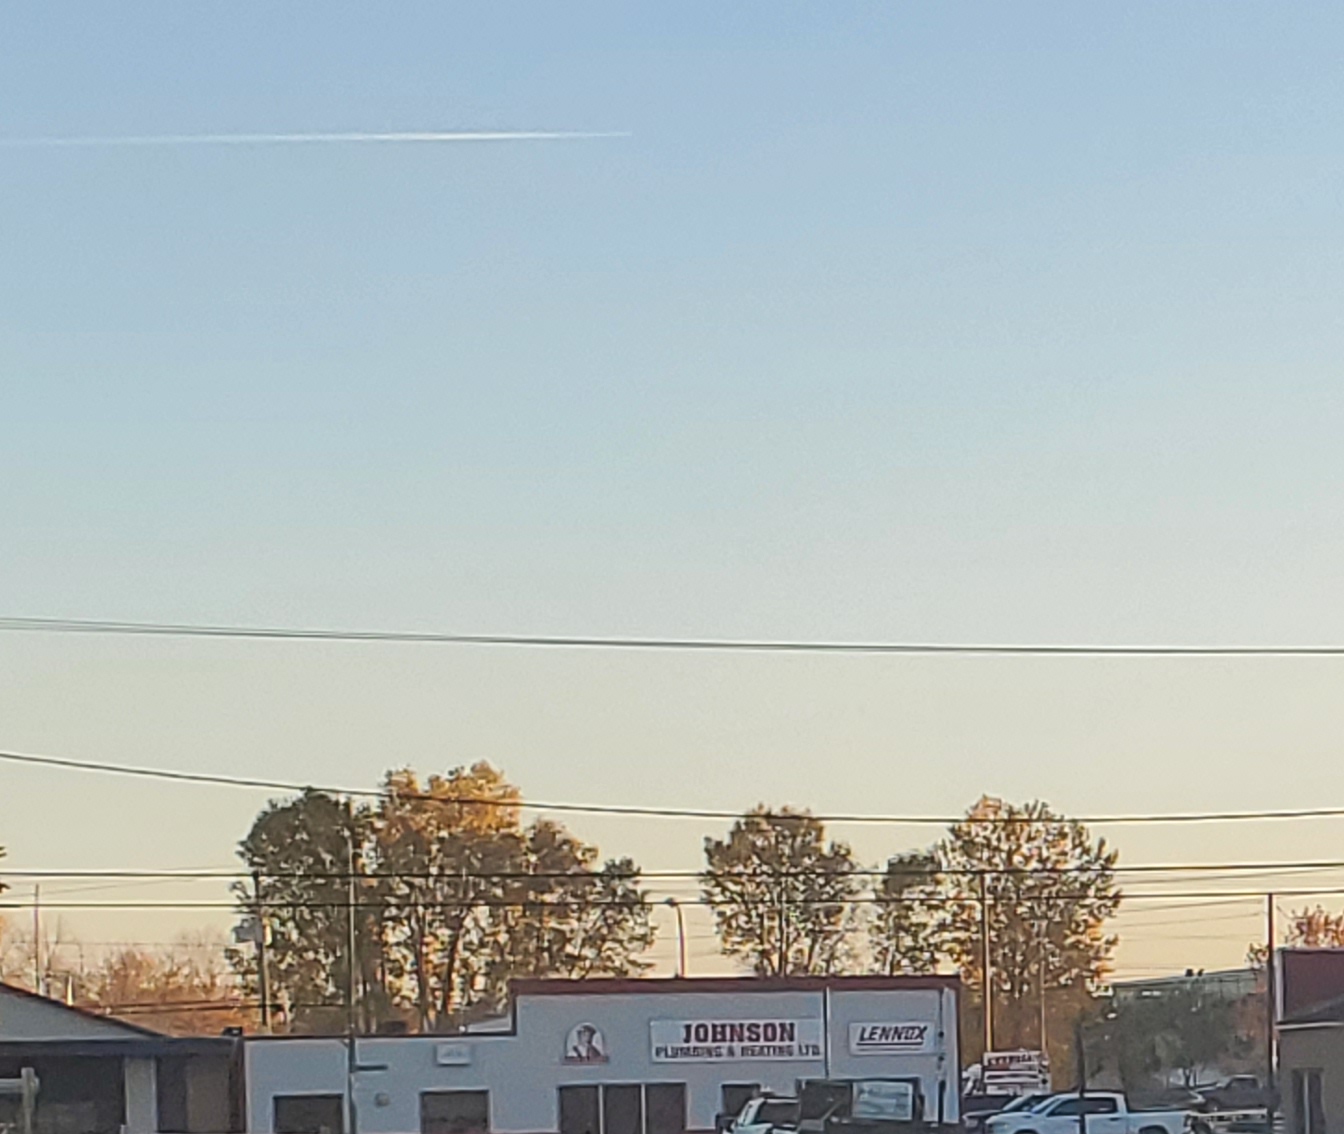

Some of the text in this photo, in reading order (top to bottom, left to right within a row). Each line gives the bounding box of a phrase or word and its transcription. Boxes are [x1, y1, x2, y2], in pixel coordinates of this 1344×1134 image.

[683, 1022, 796, 1044] JOHNSON
[859, 1026, 928, 1041] LENNOX
[655, 1045, 723, 1059] PLUMBING
[740, 1044, 794, 1057] HEATING
